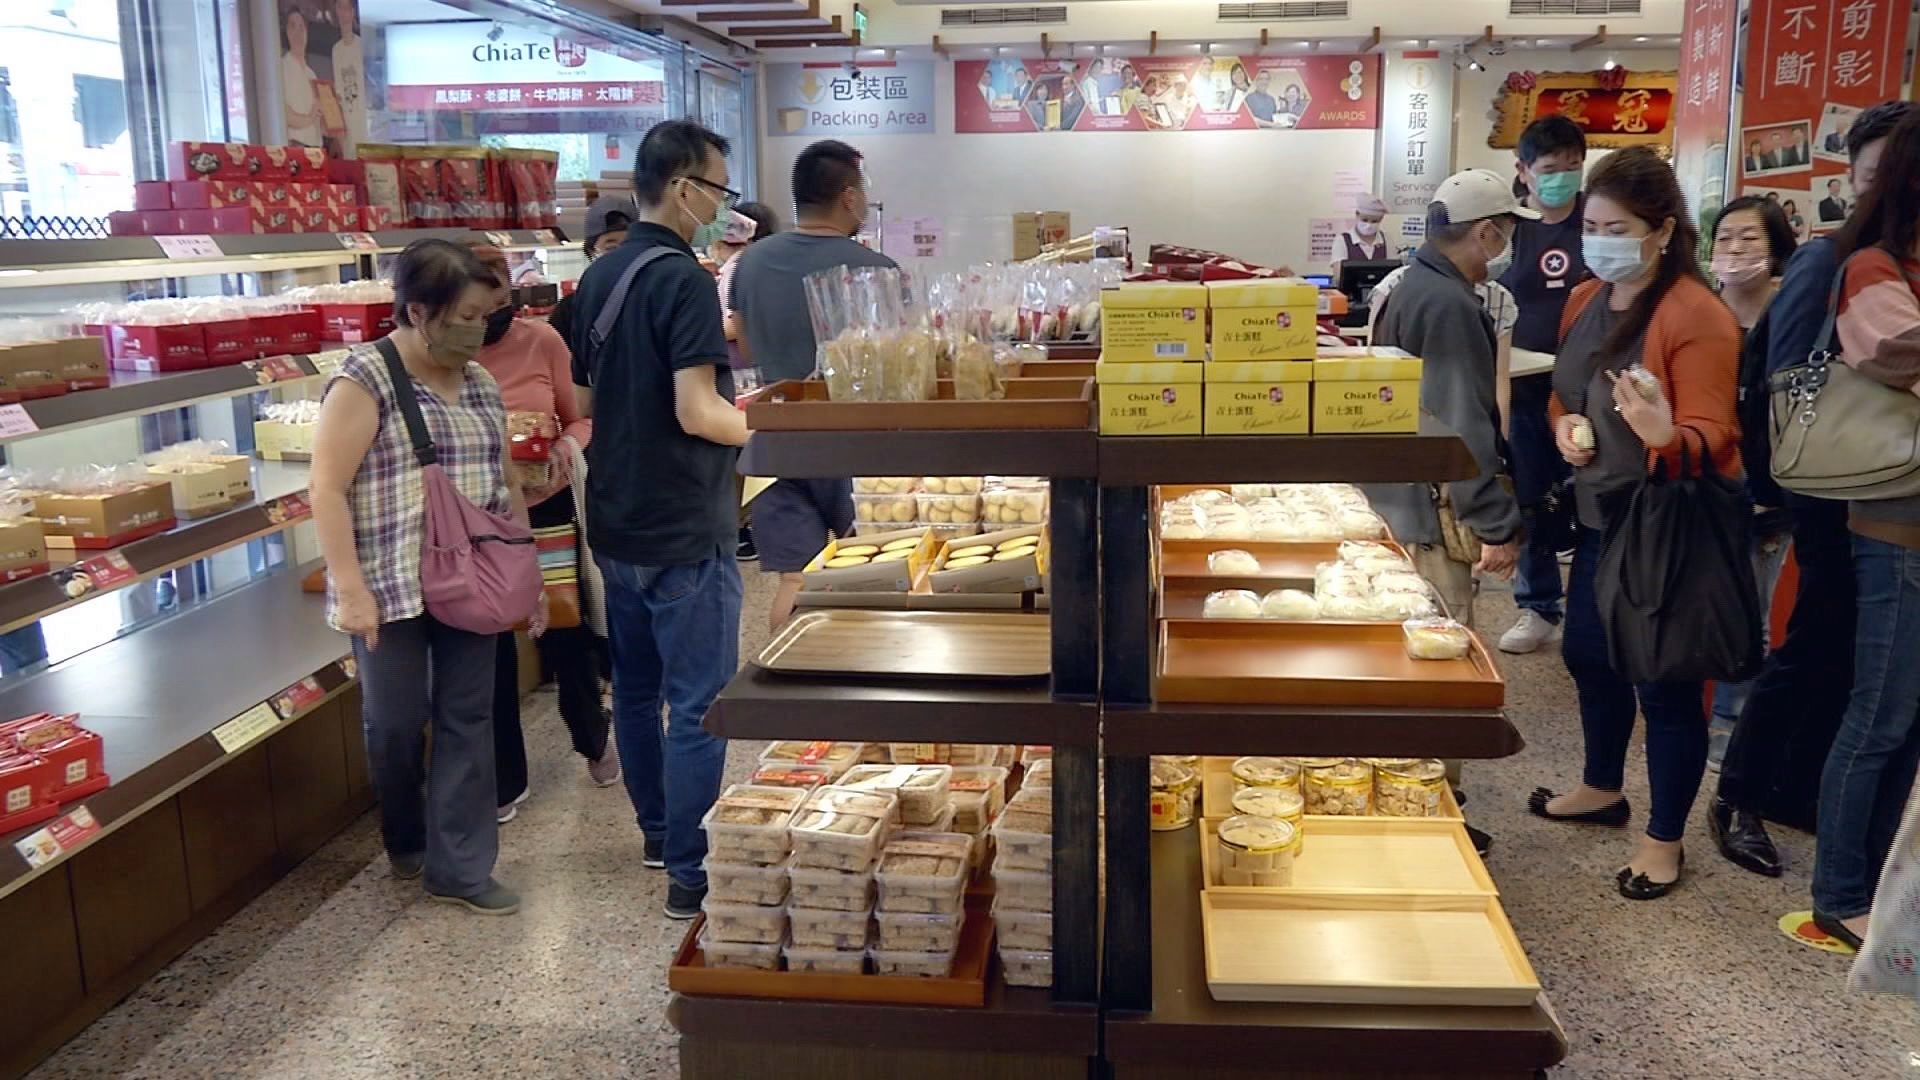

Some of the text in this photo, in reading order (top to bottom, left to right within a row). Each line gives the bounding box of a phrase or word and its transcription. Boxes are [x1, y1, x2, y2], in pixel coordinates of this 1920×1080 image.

[472, 43, 551, 62] ChiaTe
[1775, 5, 1817, 88] 不斷
[1832, 0, 1877, 88] 剪影
[830, 76, 909, 101] 包裝區
[811, 110, 929, 129] Packing Area
[1318, 111, 1367, 121] AWARDS
